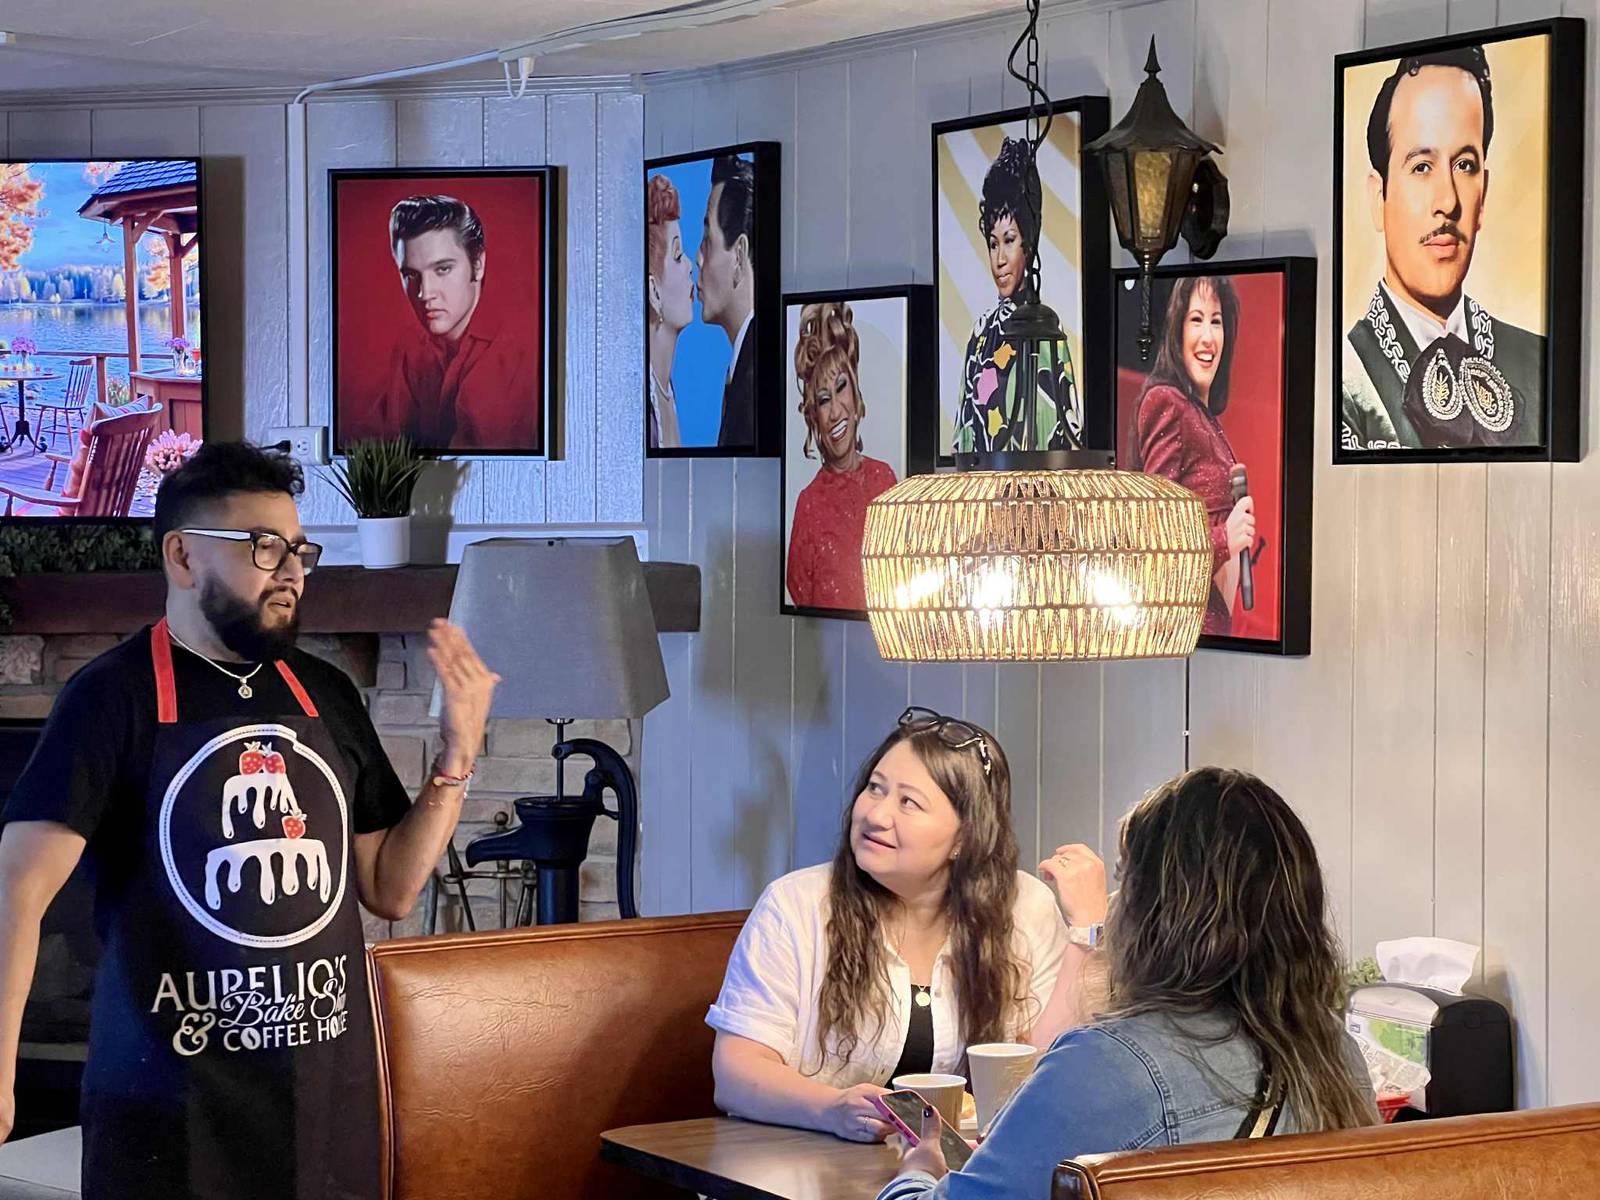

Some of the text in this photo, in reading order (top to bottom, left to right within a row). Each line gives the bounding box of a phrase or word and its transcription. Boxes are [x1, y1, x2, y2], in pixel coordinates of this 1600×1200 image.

[151, 954, 347, 1013] AURELIO'S
[218, 991, 305, 1028] Bake
[172, 1012, 216, 1056] &
[223, 1022, 311, 1051] COFFEE
